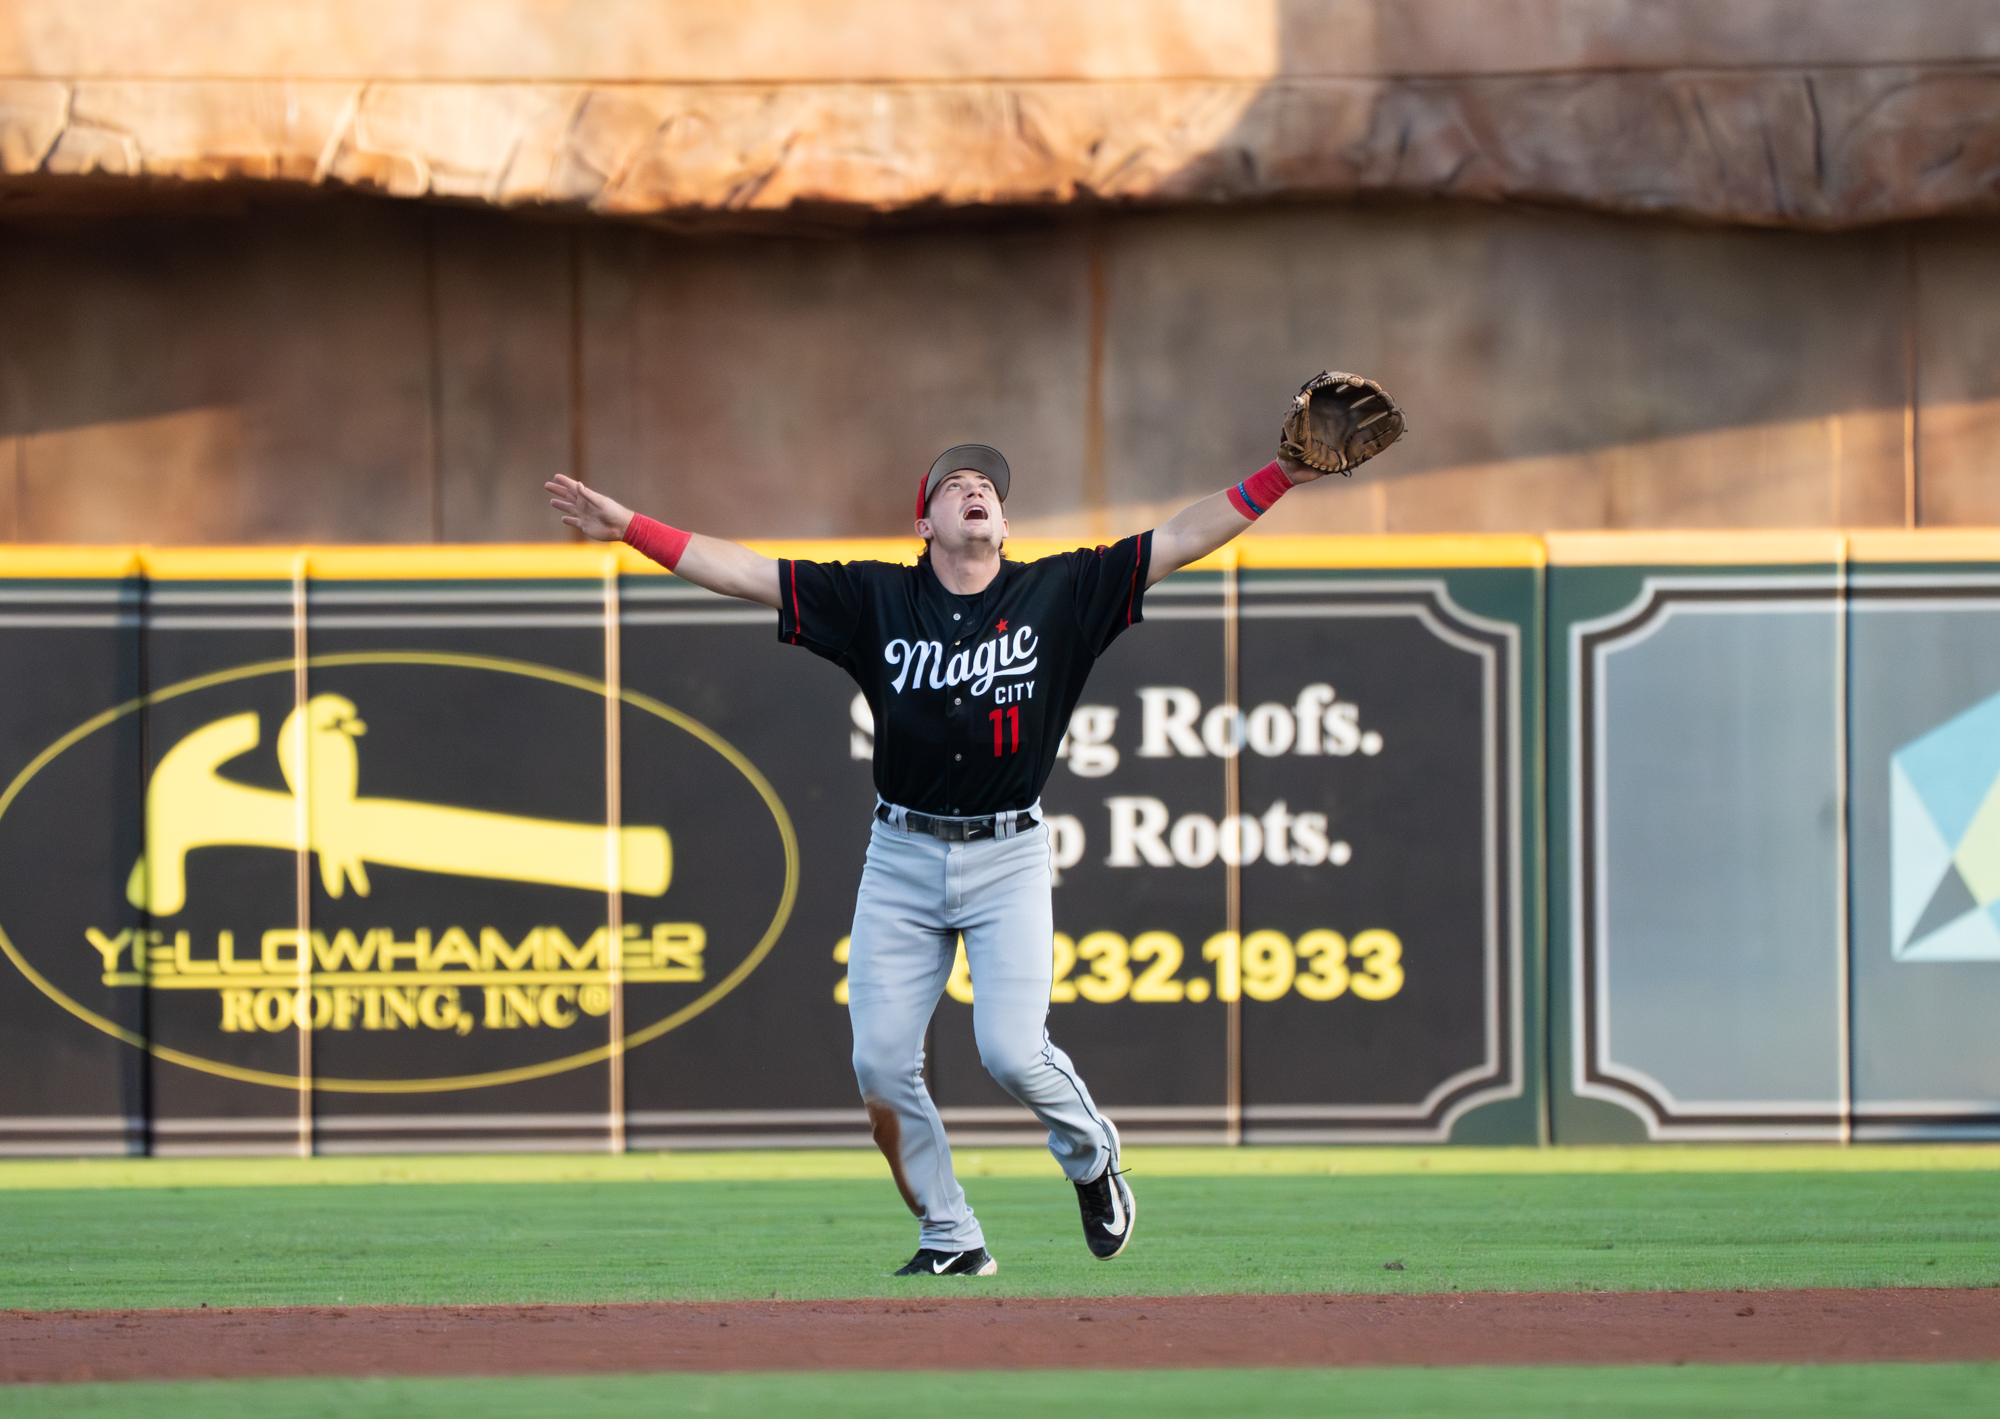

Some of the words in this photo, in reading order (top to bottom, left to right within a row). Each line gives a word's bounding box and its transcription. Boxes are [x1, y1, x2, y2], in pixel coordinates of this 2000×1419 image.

[884, 619, 1038, 697] Magic
[994, 681, 1036, 704] CITY
[989, 706, 1019, 757] 11
[1136, 685, 1383, 758] Roofs.
[1106, 796, 1352, 867] Roots.
[85, 924, 706, 972] YELLOWHAMMER
[220, 987, 475, 1036] ROOFING,
